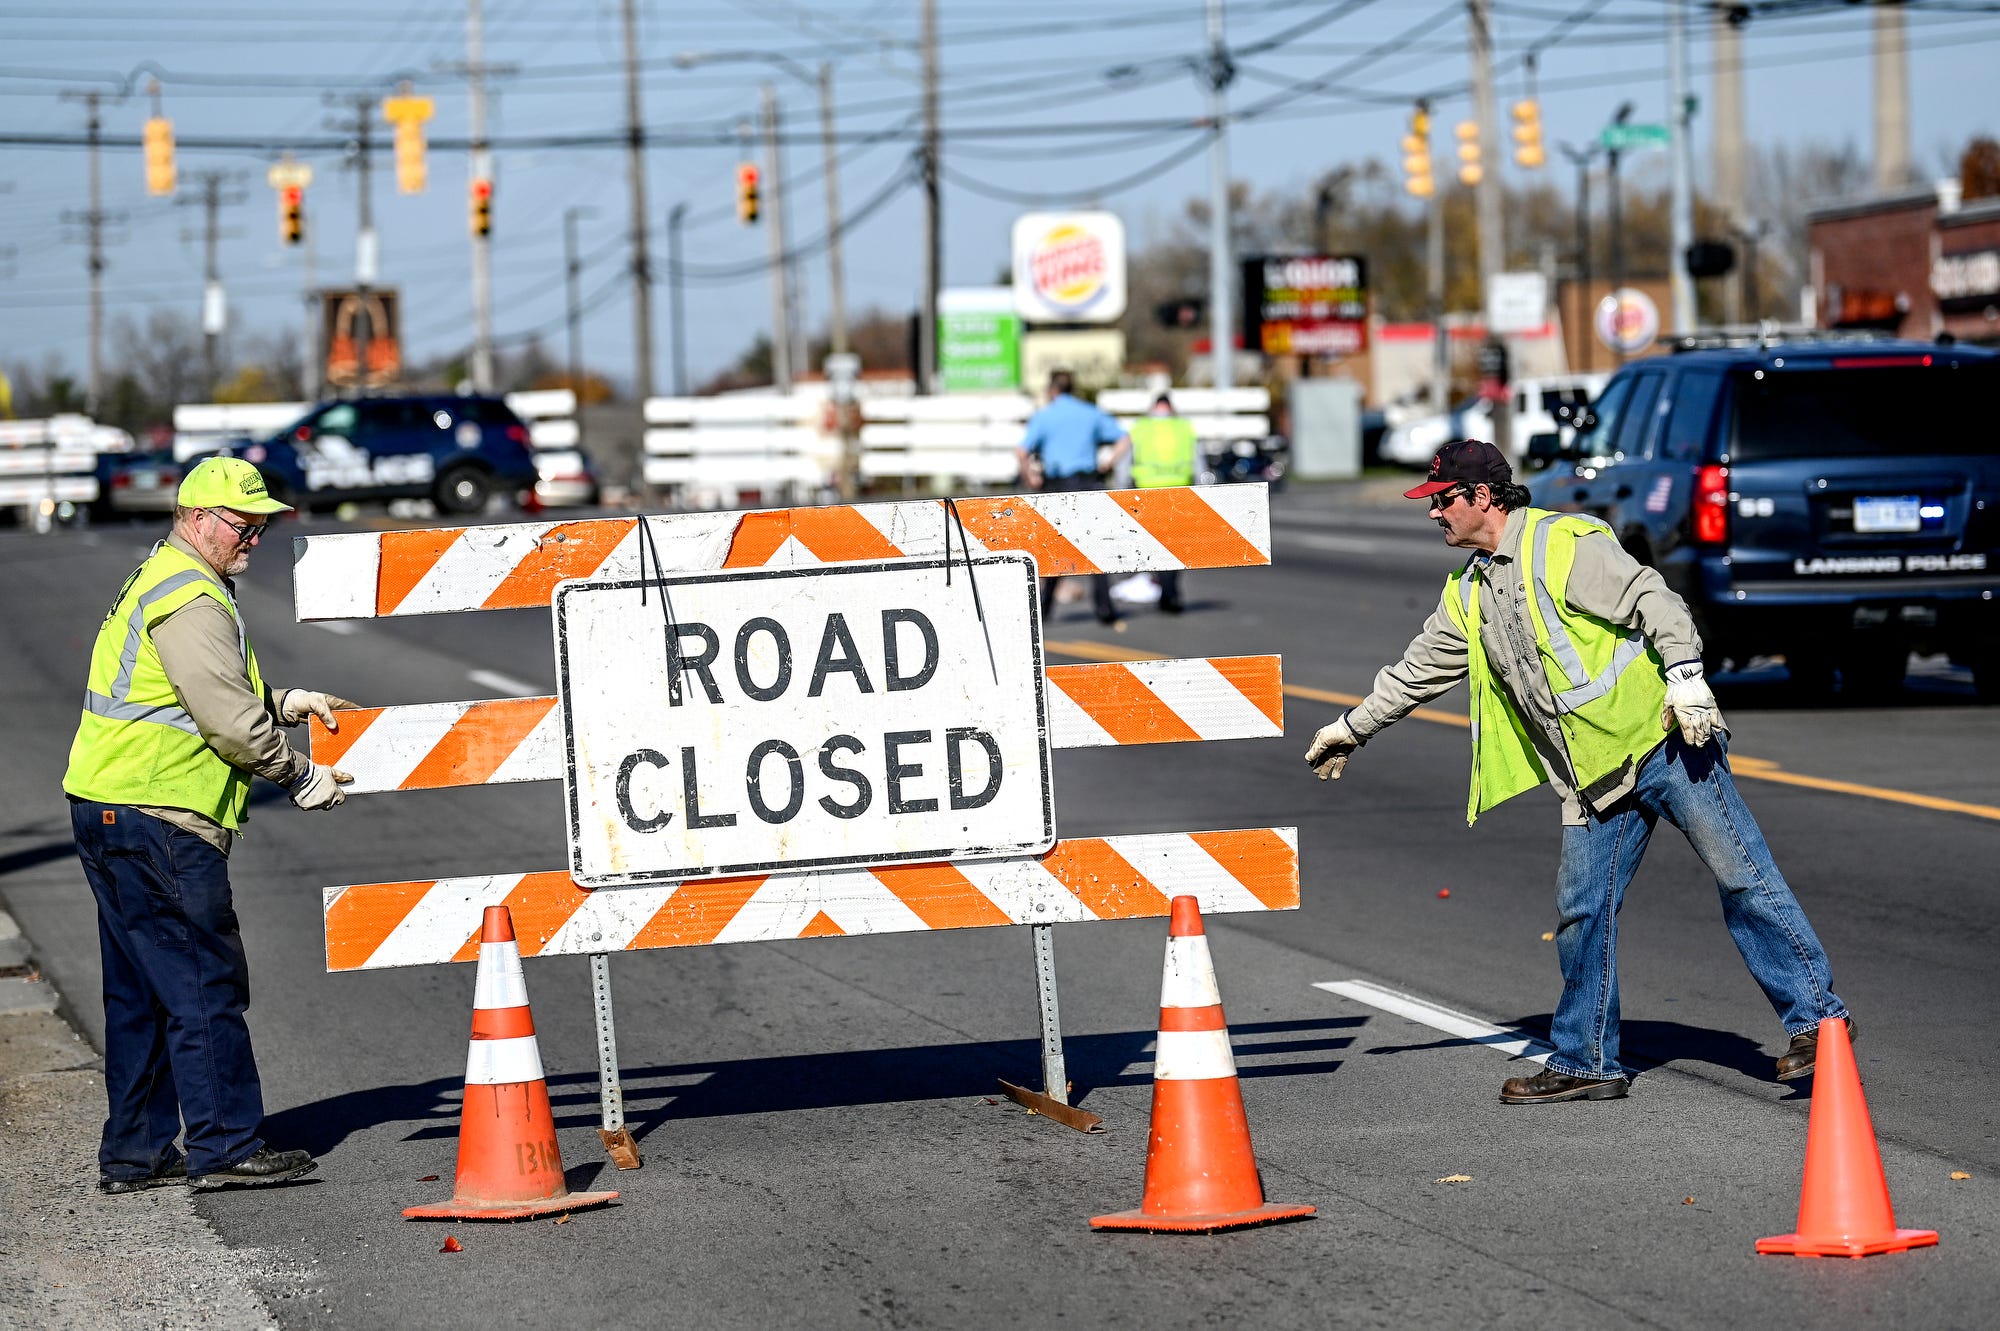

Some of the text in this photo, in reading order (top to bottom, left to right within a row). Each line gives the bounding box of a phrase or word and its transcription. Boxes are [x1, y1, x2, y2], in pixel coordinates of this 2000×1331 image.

[1795, 554, 1987, 574] LANSING POLICE
[664, 608, 939, 707] ROAD
[615, 726, 1003, 833] CLOSED
